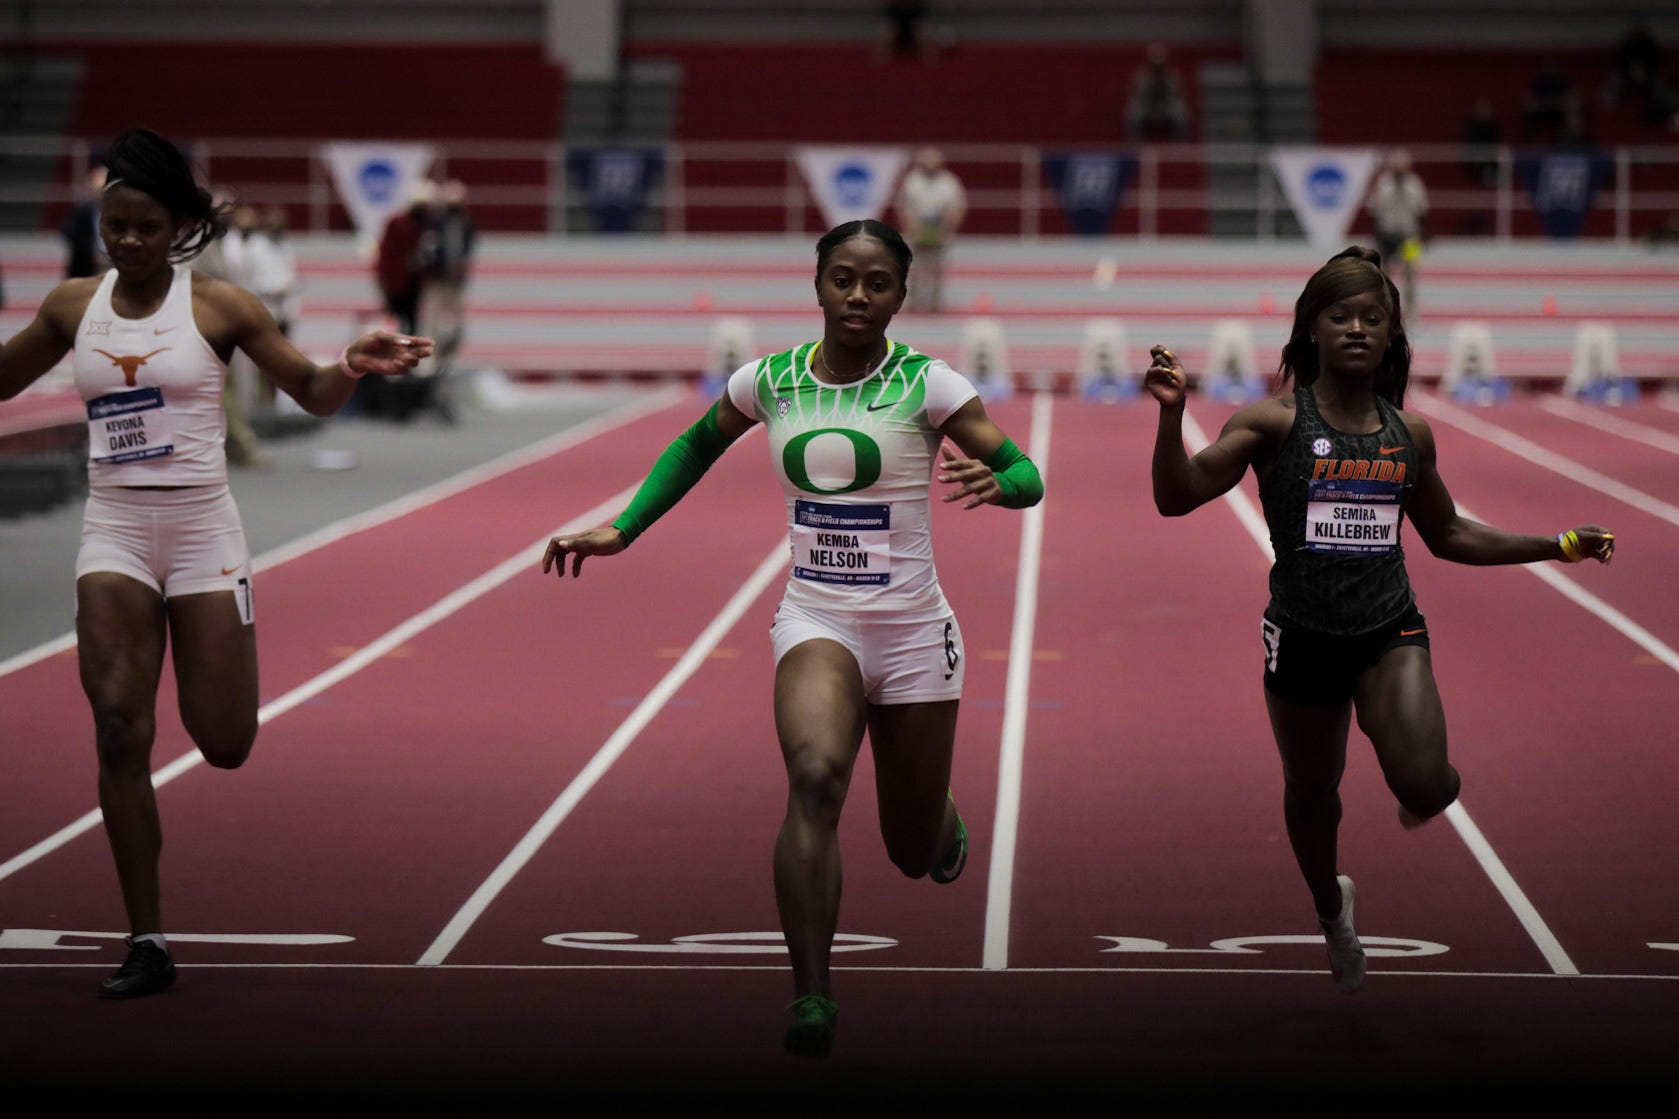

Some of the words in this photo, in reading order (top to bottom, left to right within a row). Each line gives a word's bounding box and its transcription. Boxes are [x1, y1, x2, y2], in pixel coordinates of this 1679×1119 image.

[106, 416, 145, 433] KEVONA
[109, 432, 147, 450] DAVIS
[1314, 438, 1332, 456] SEC
[783, 428, 881, 494] O
[1312, 459, 1407, 484] FLORIDA
[1333, 507, 1376, 521] SEMIRA
[1314, 522, 1391, 540] KILLEBREW
[817, 533, 859, 548] KEMBA
[810, 549, 868, 568] NELSON
[238, 577, 250, 621] 7
[944, 622, 958, 680] 6
